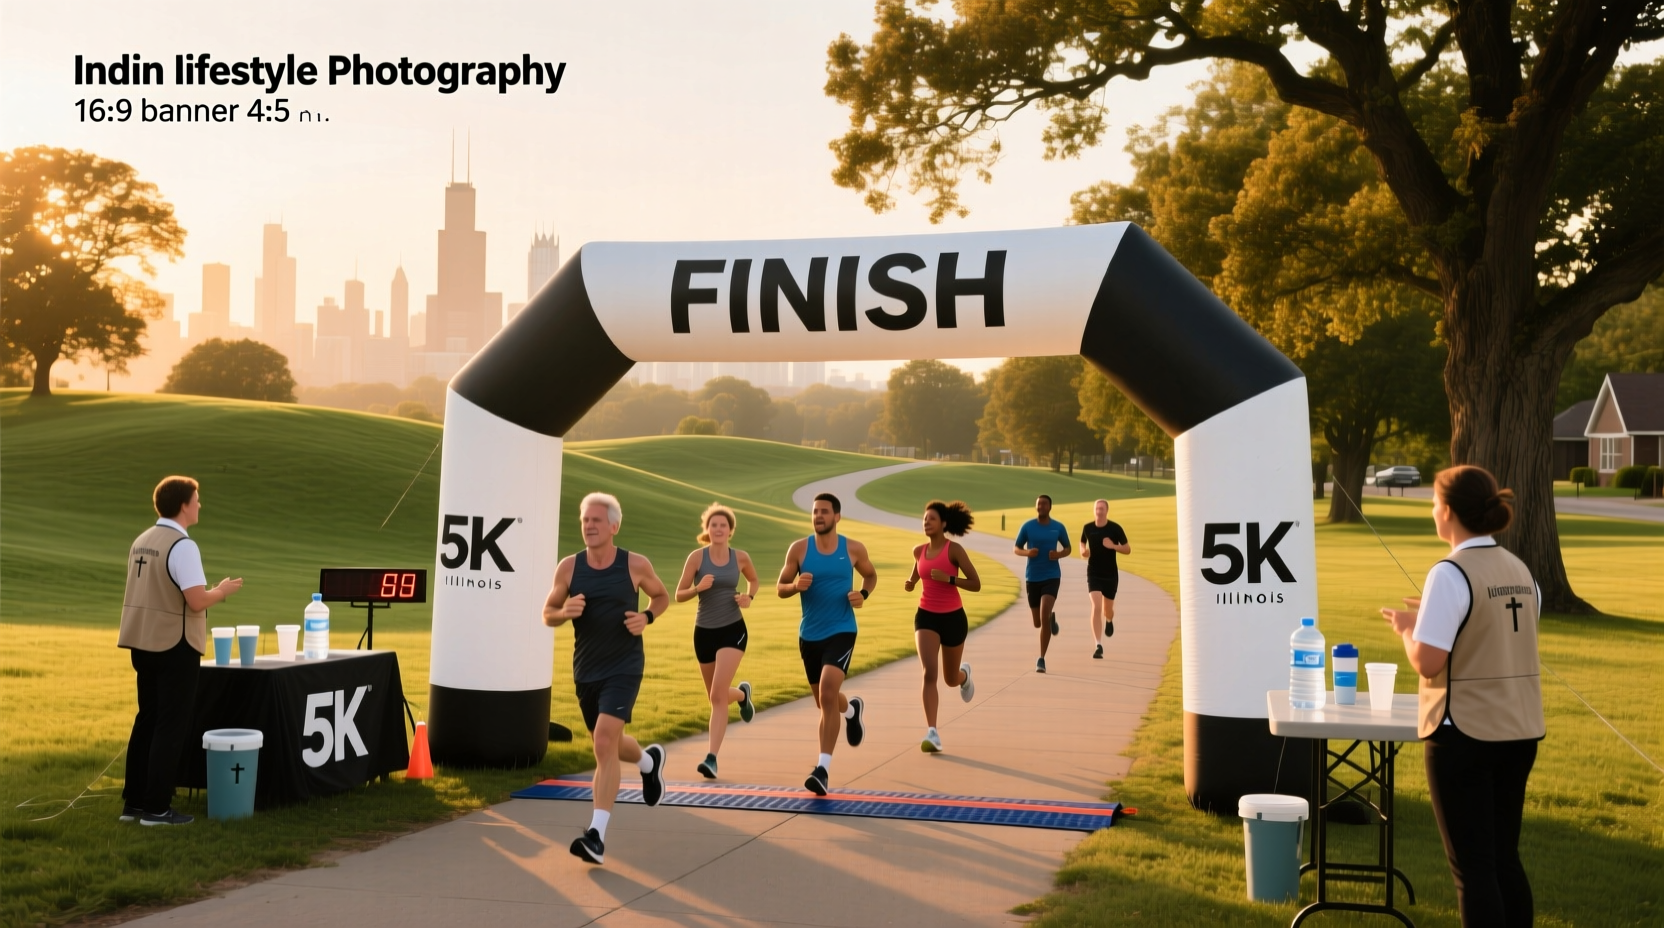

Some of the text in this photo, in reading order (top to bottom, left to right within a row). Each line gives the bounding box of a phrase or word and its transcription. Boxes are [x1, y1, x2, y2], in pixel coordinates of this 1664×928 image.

[670, 250, 1007, 334] FINISH
[440, 514, 516, 572] 5K
[1200, 521, 1297, 585] 5K
[302, 685, 369, 768] 5K
